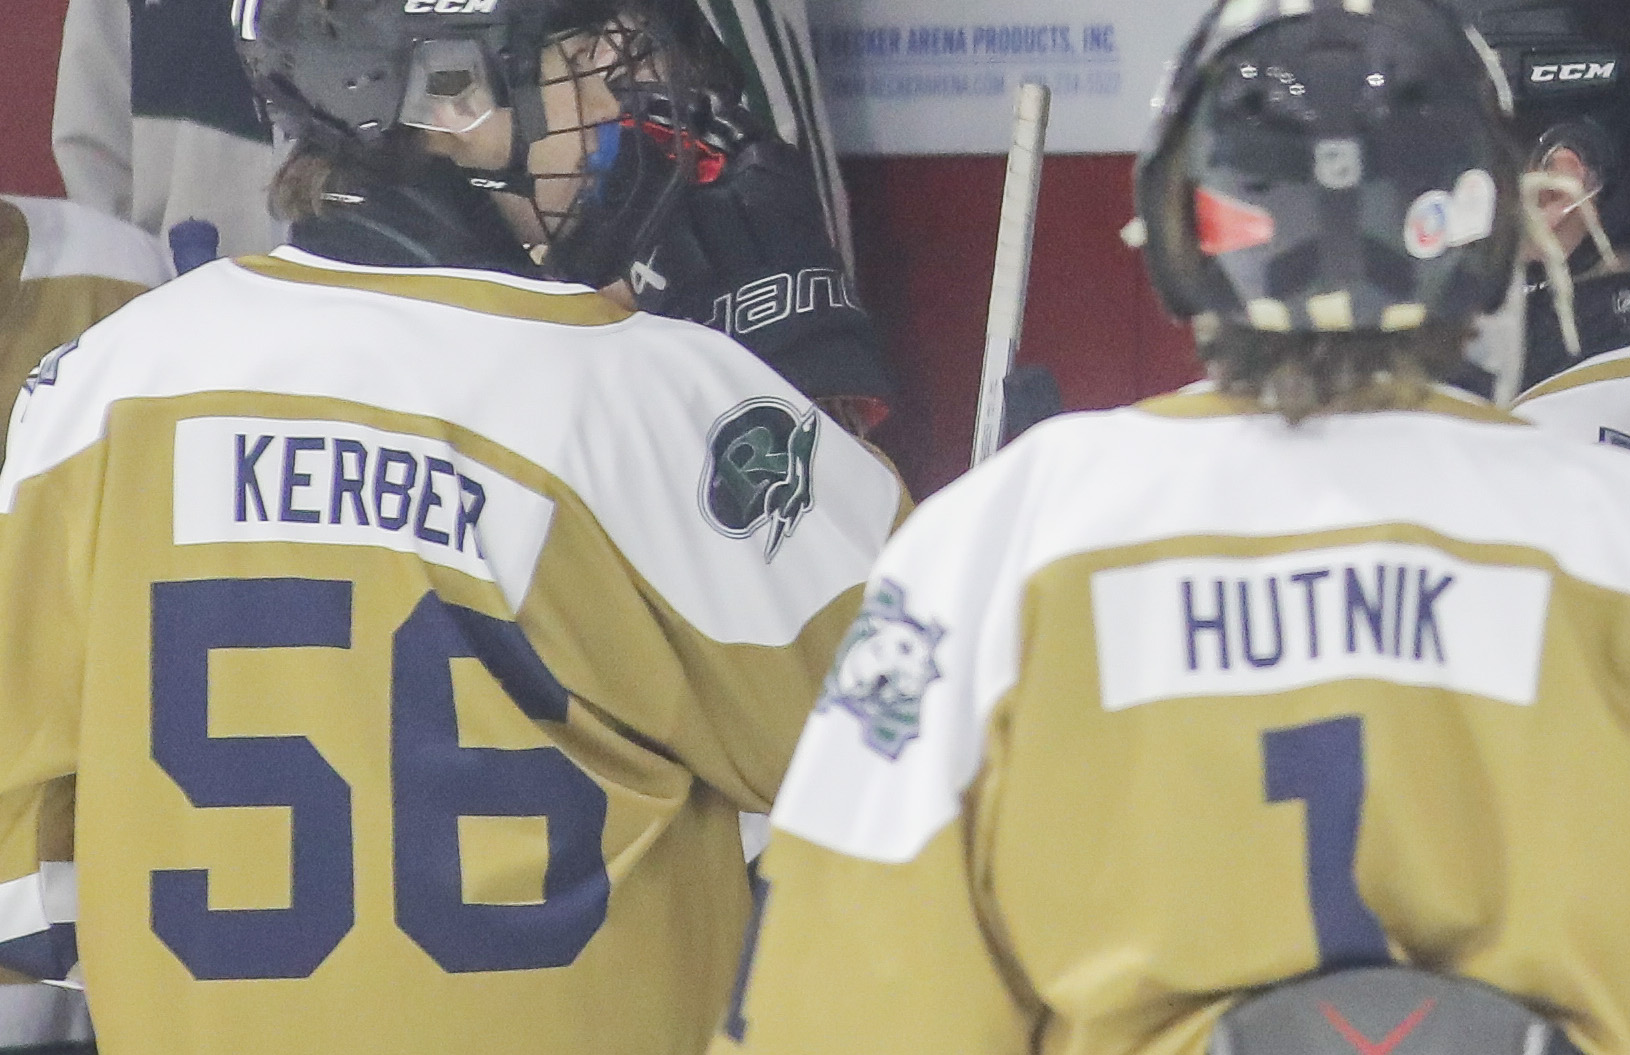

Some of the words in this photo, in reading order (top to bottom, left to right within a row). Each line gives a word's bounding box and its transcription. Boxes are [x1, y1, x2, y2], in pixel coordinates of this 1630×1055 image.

[1530, 59, 1617, 83] CCM
[234, 434, 487, 561] KERBER
[1180, 564, 1455, 672] HUTNIK
[150, 577, 609, 981] 56
[1261, 711, 1393, 970] 1
